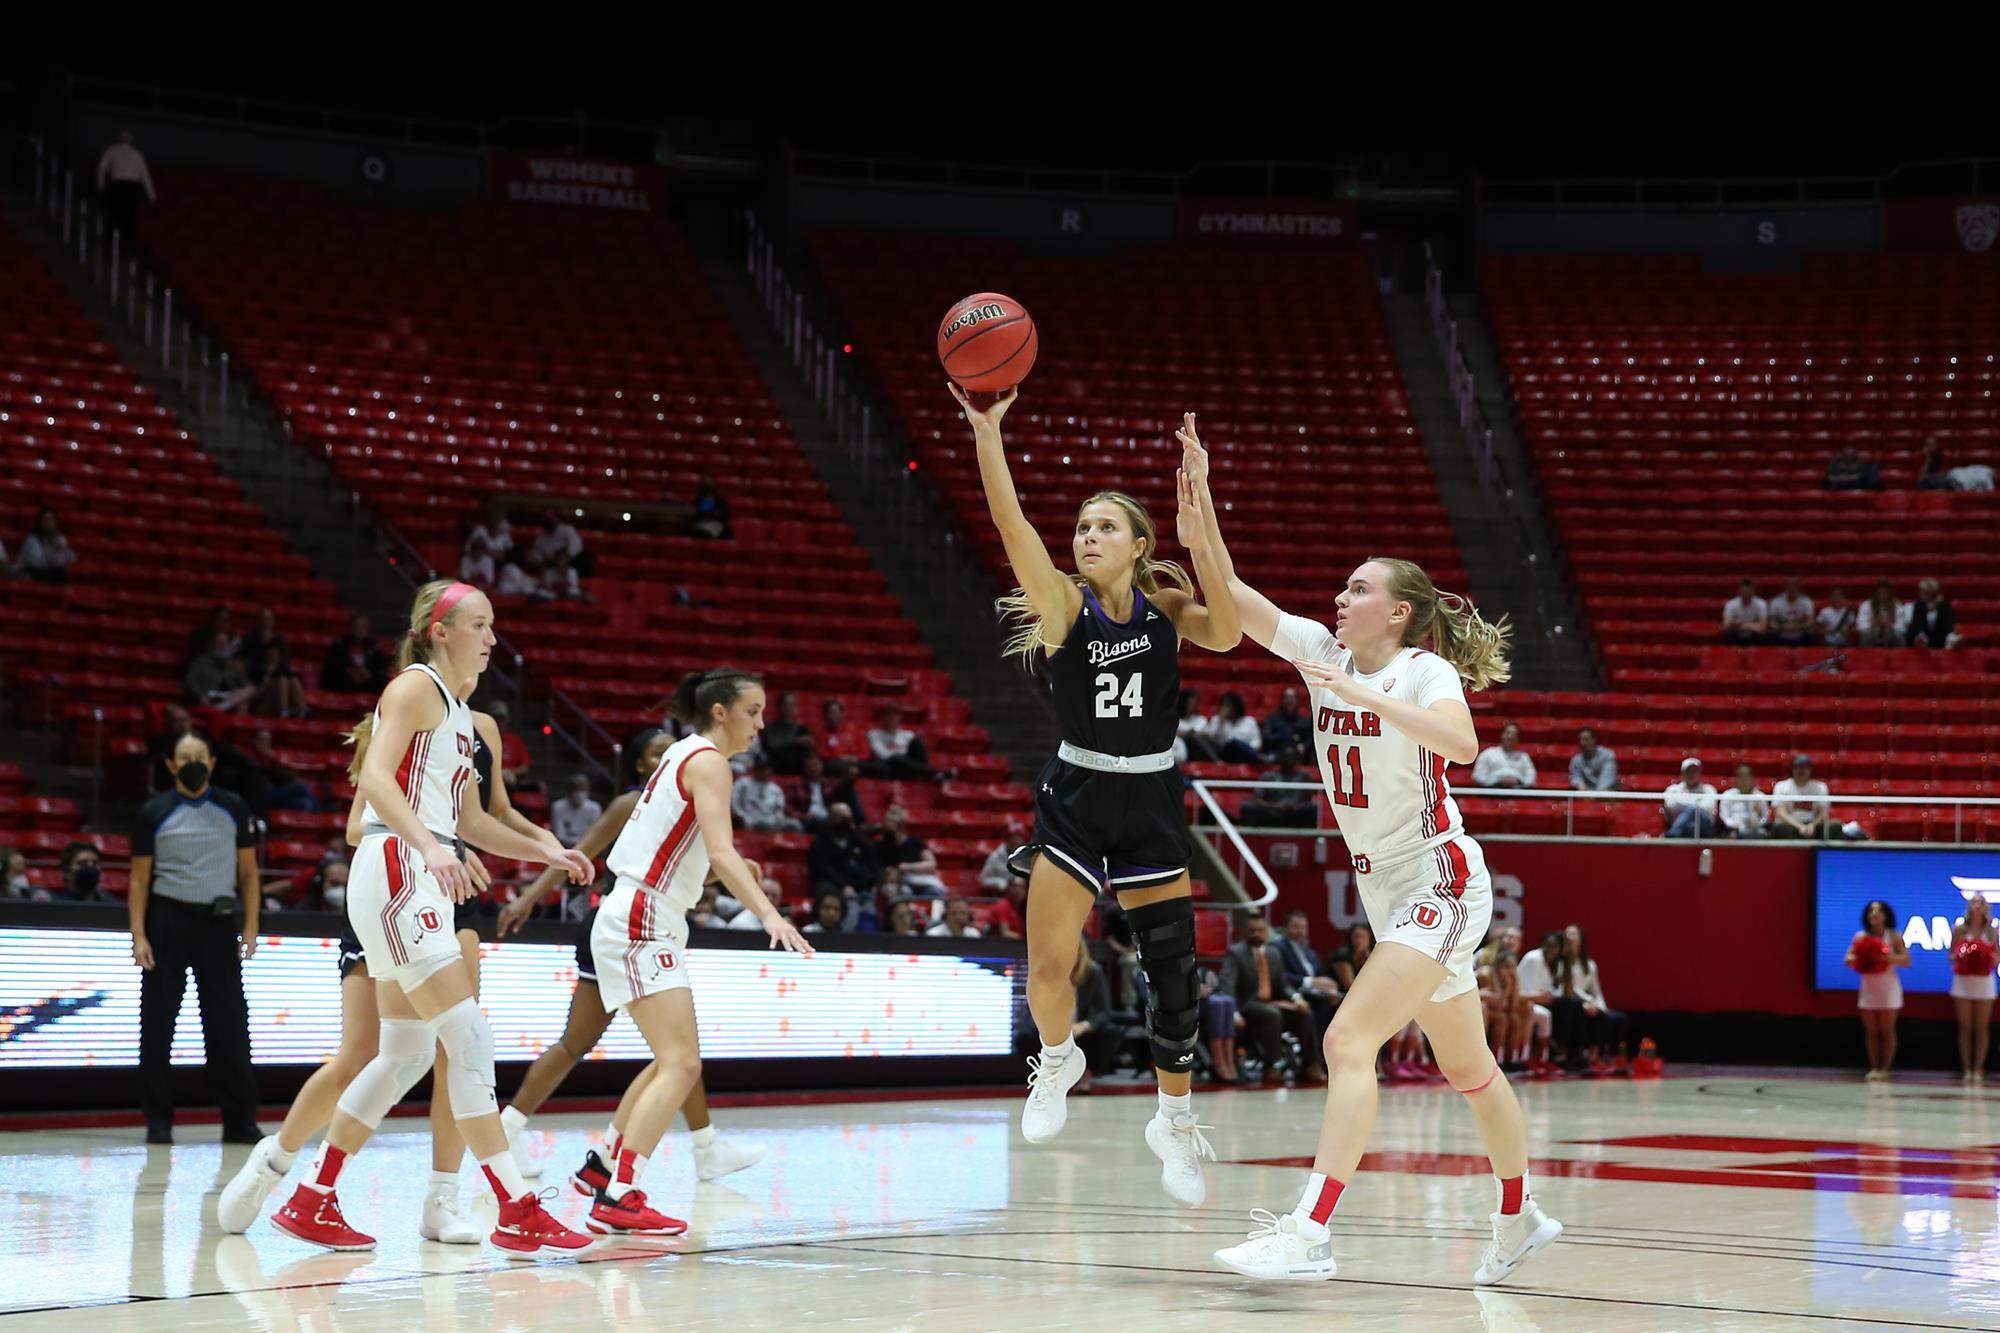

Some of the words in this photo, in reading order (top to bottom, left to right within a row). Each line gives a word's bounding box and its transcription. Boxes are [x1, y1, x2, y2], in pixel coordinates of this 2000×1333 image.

[362, 156, 385, 182] Q
[529, 159, 633, 186] WOMEN'S
[508, 181, 651, 210] BASKETBALL
[1062, 209, 1080, 232] R
[1198, 213, 1343, 236] GYMNASTICS
[1758, 221, 1775, 244] S
[944, 303, 1007, 340] Wilson
[1087, 634, 1152, 667] Bisons
[1095, 672, 1143, 718] 24
[1318, 706, 1381, 736] UTAH
[1327, 744, 1368, 808] 11
[421, 911, 438, 929] U
[1416, 905, 1438, 926] U
[658, 953, 674, 968] U
